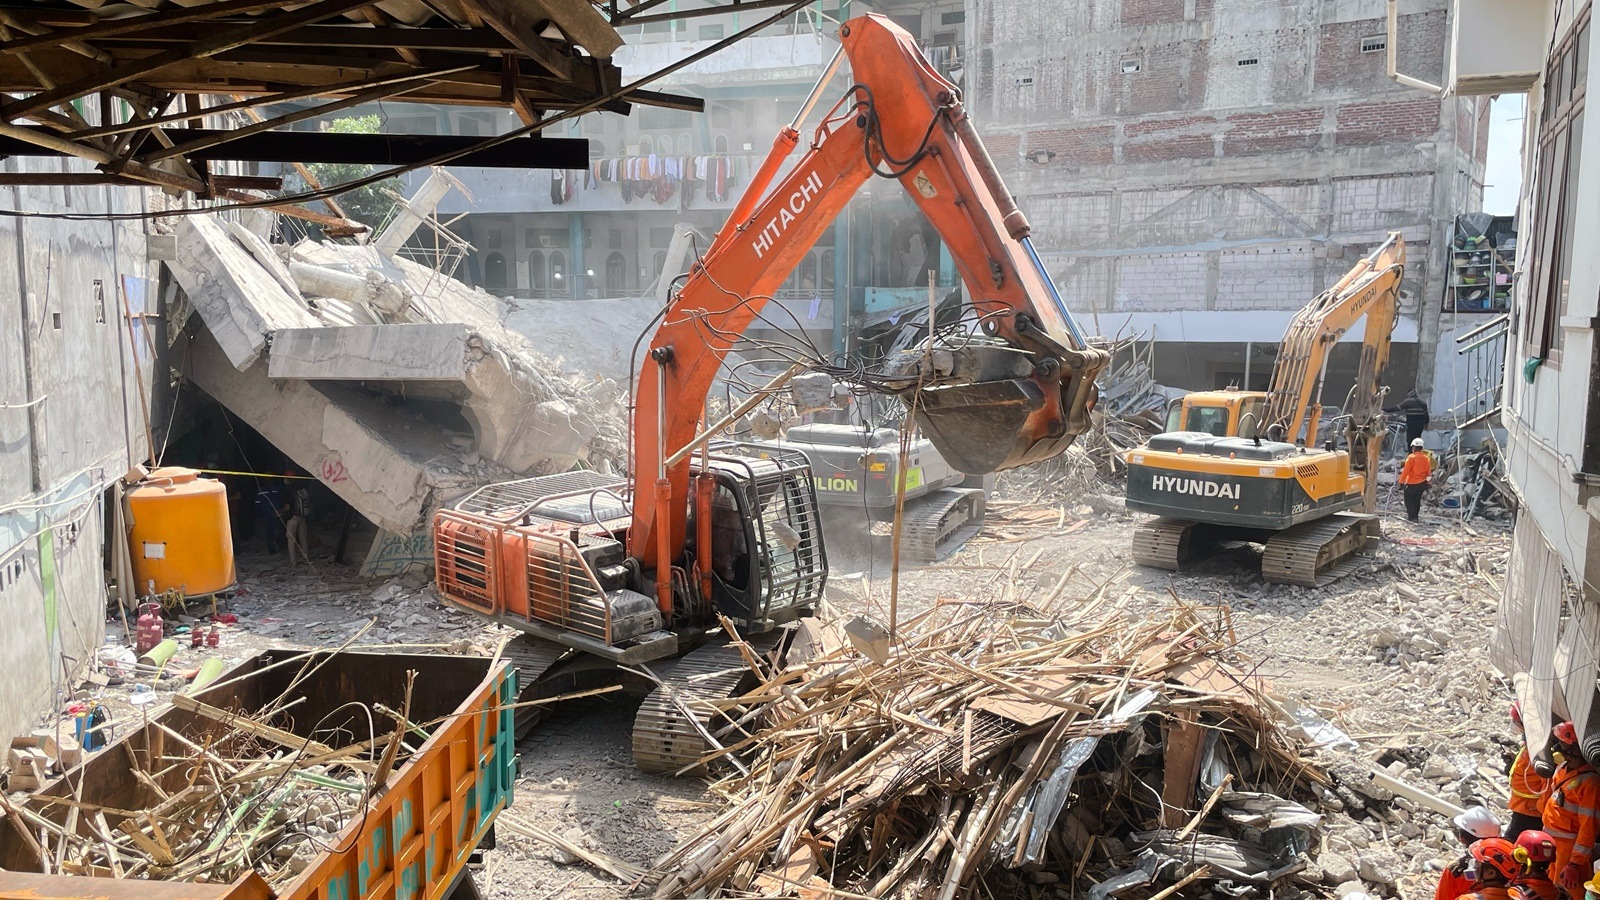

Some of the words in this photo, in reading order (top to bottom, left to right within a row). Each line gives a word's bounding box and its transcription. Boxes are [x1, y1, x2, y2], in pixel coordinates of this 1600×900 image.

[751, 170, 823, 258] HITACHI
[1350, 285, 1377, 315] HYUNDAI
[1151, 474, 1241, 500] HYUNDAI
